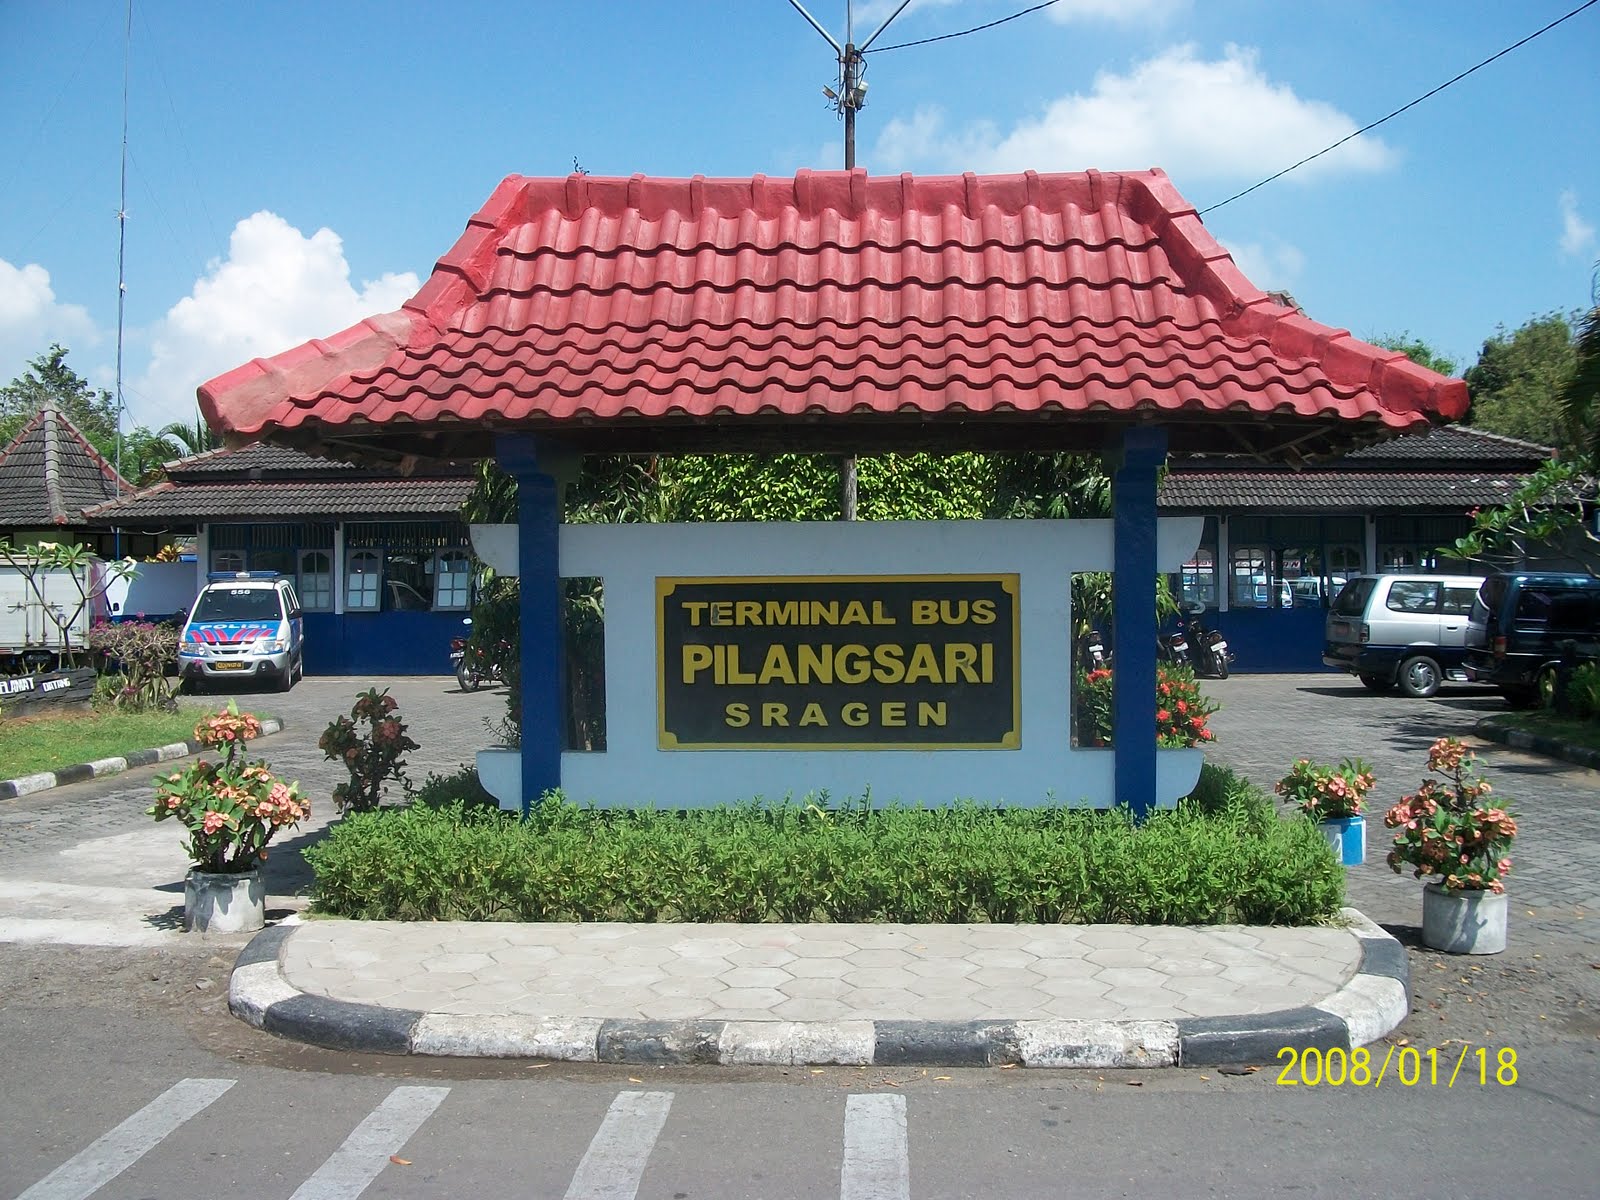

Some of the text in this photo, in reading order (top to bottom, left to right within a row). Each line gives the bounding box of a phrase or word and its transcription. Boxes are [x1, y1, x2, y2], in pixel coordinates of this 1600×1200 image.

[682, 600, 997, 626] TERMINAL BUS
[681, 643, 993, 685] PILANGSARI
[42, 677, 71, 692] DATANG
[725, 701, 947, 727] SRAGEN
